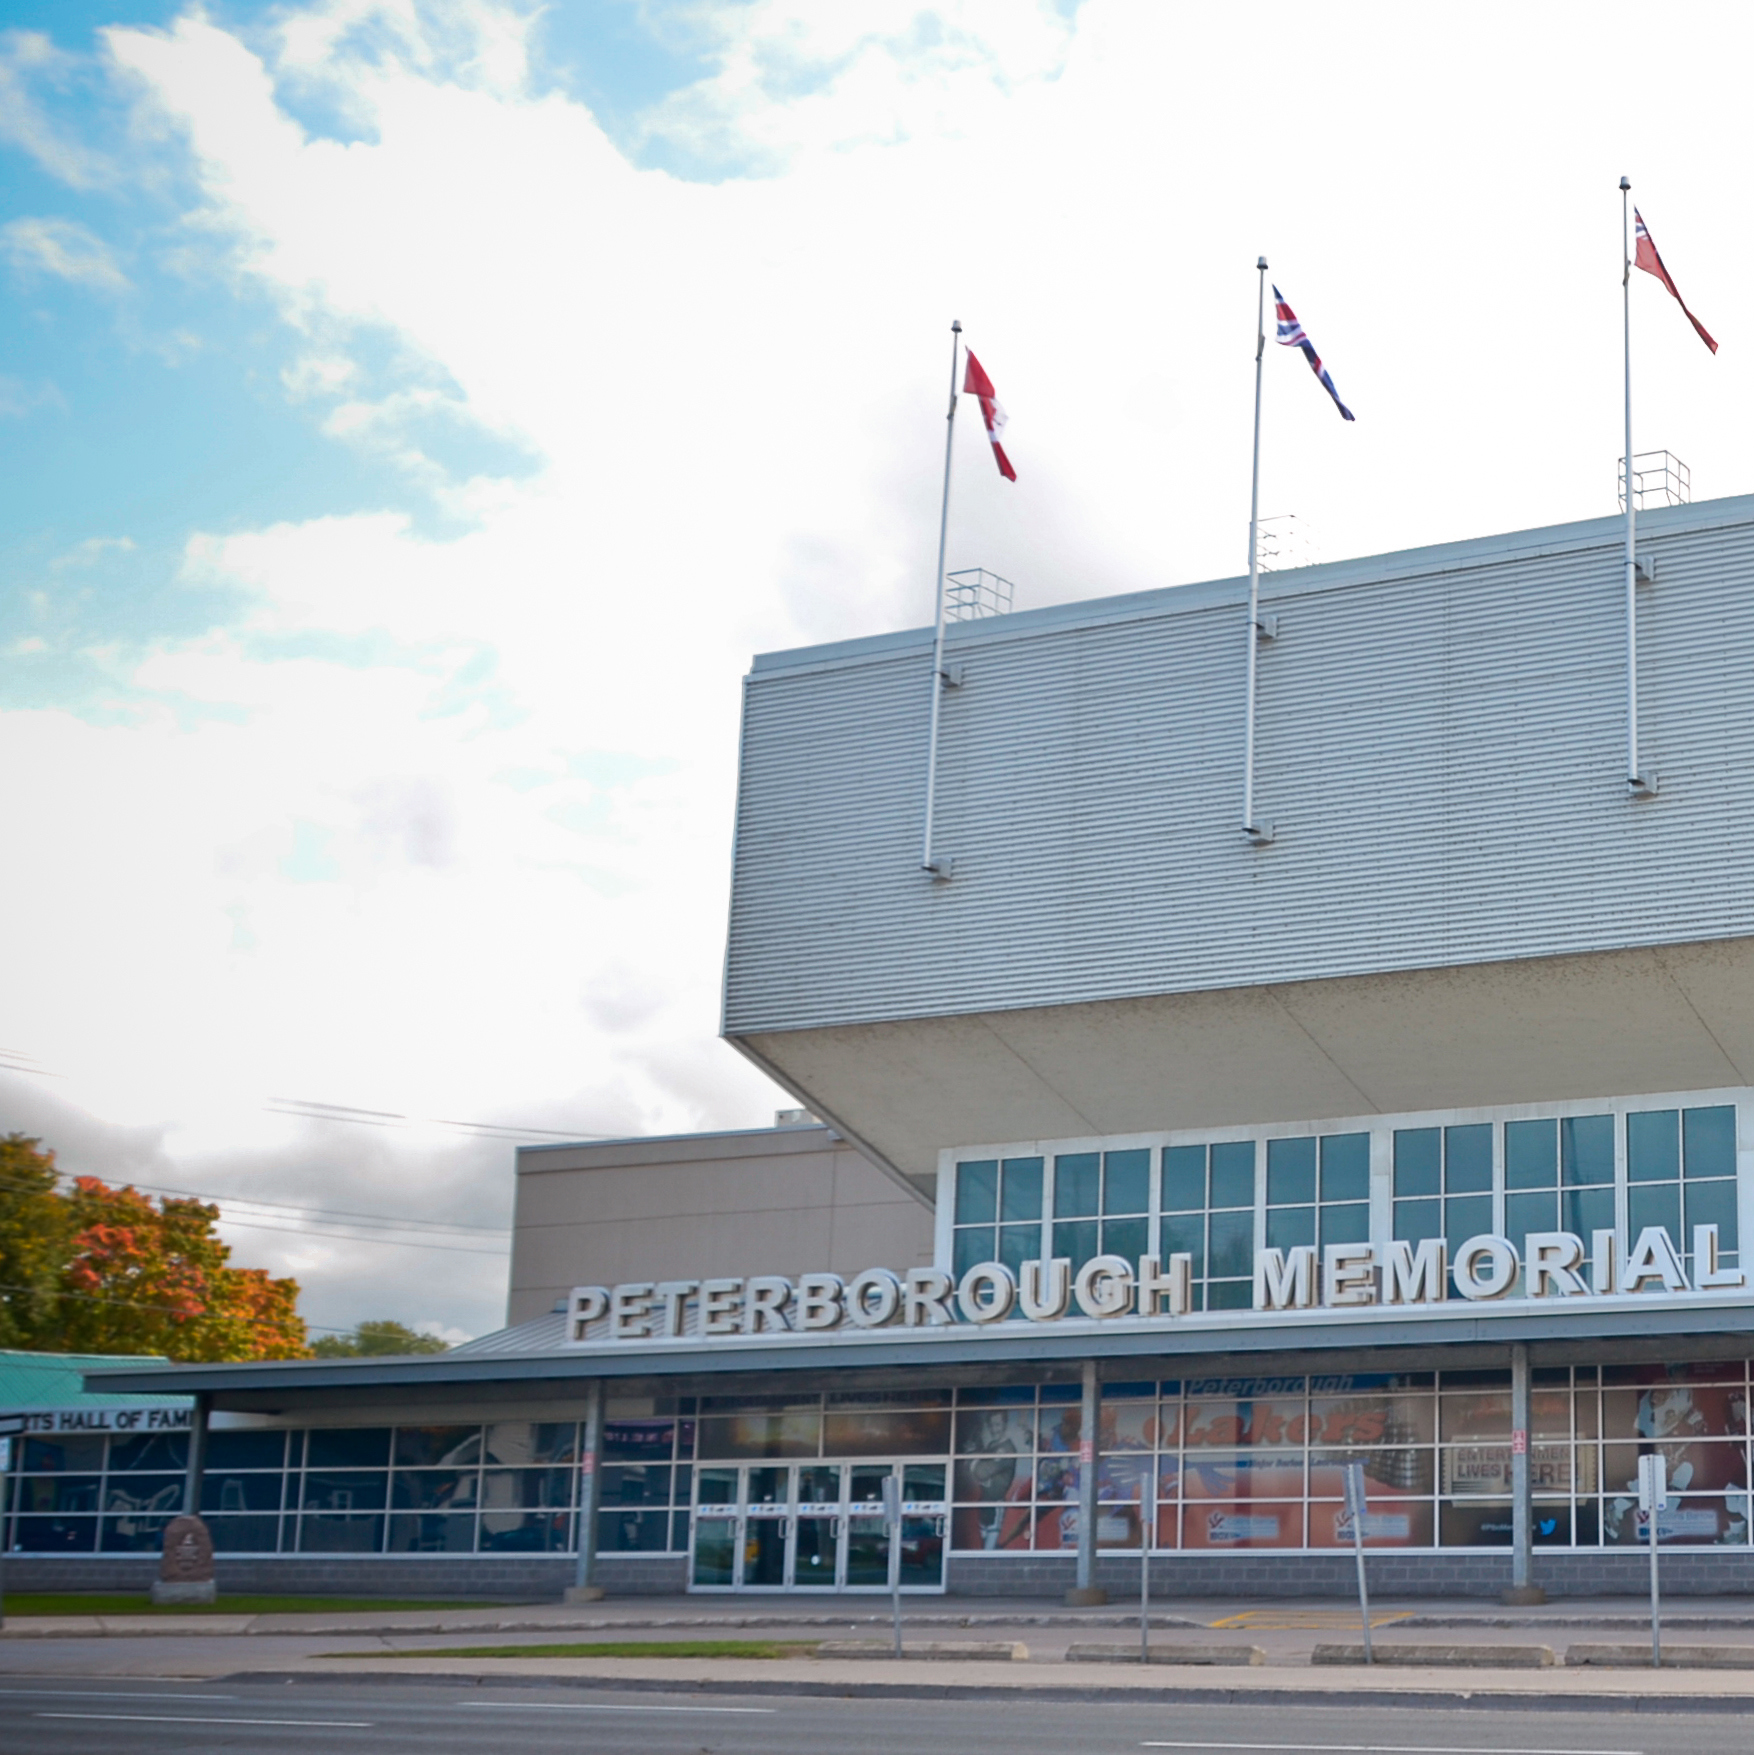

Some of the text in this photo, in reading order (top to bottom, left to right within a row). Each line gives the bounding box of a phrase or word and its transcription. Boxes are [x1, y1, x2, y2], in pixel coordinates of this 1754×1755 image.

[566, 1253, 1192, 1341] PETERBOROUGH
[1253, 1223, 1745, 1310] MEMORIAL
[1188, 1375, 1354, 1397] Peterborough
[59, 1411, 111, 1430] HALL
[115, 1411, 145, 1429] OF
[148, 1410, 193, 1429] FAM
[1143, 1404, 1389, 1446] Lakers
[1458, 1463, 1501, 1479] LIVES
